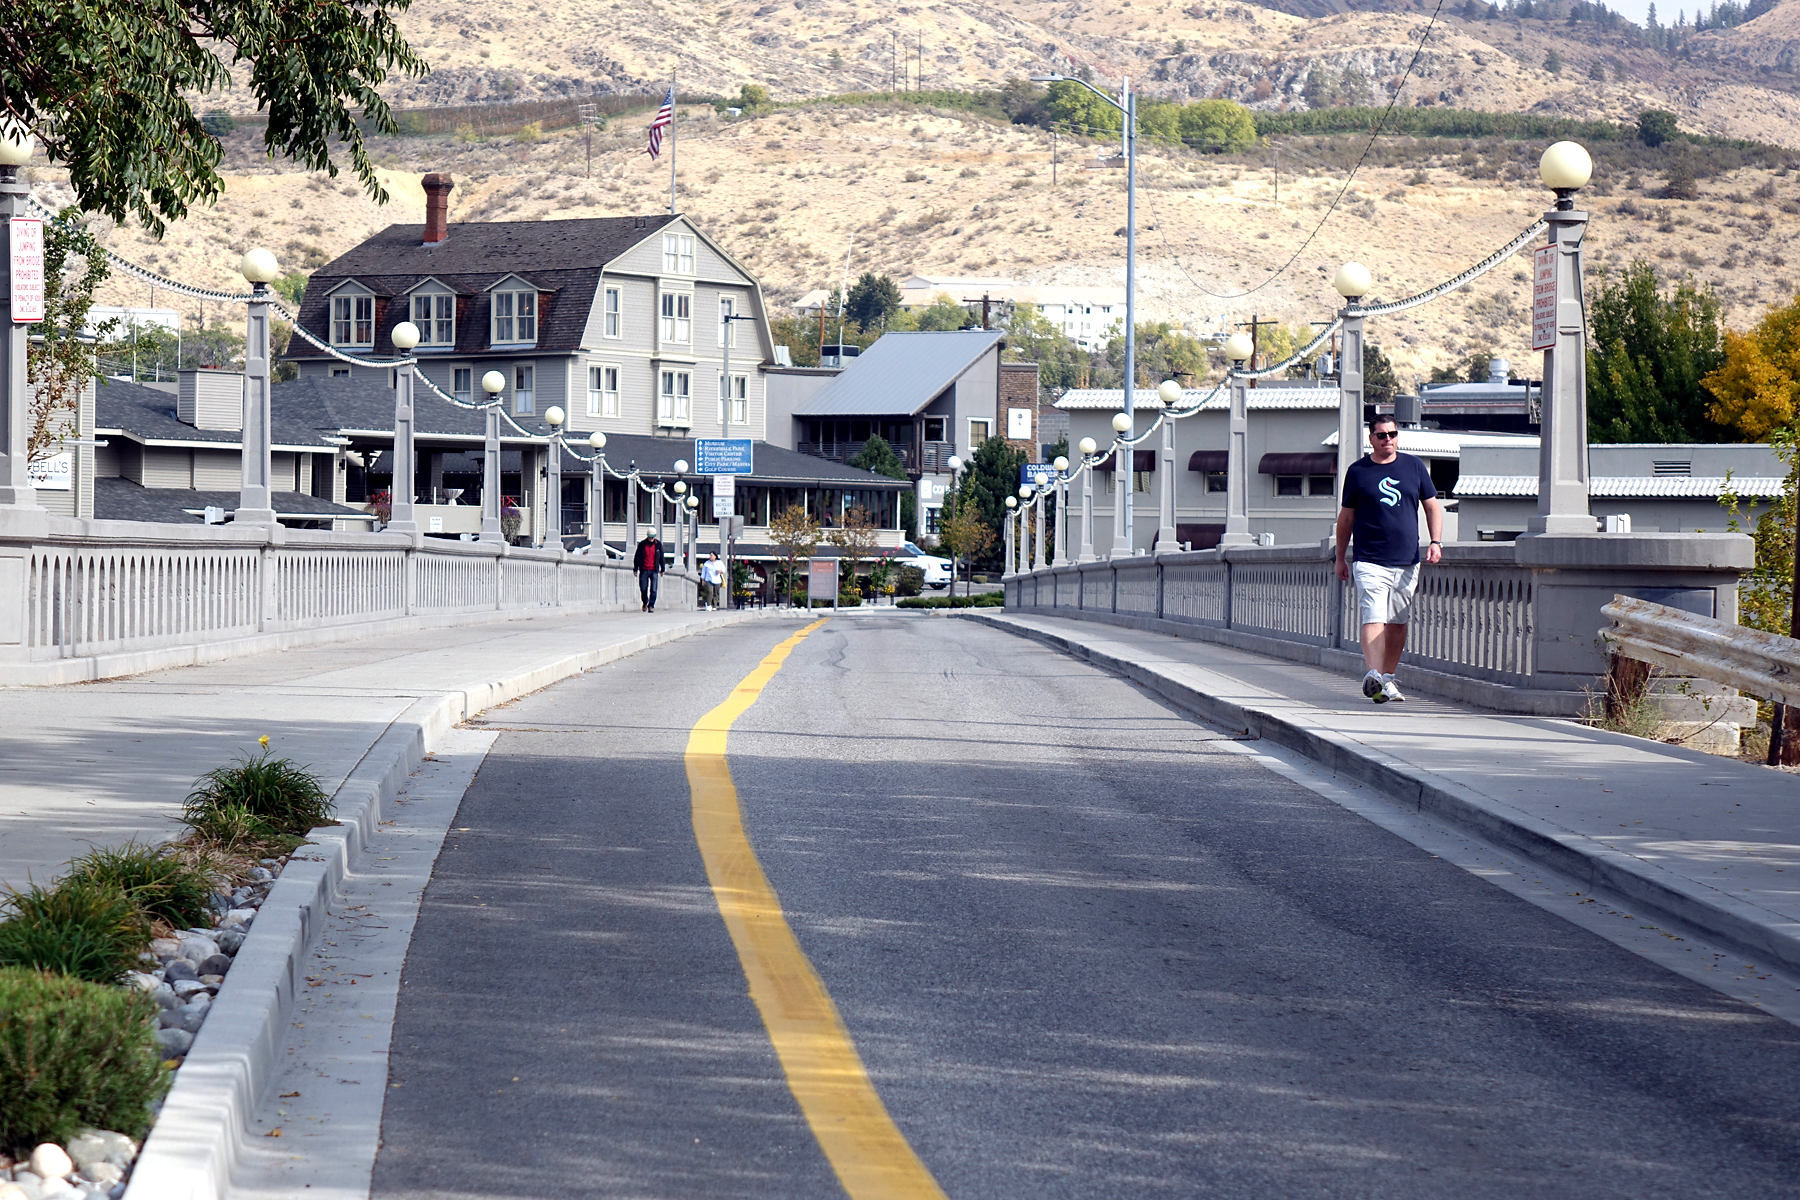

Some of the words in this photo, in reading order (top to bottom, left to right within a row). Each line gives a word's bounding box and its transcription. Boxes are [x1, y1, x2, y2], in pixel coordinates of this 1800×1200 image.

[16, 227, 30, 237] DIVING
[31, 227, 37, 237] OR
[18, 242, 36, 252] JUMPING
[14, 256, 25, 266] FROM
[26, 256, 41, 266] BRIDGE
[1538, 254, 1548, 266] DIVING
[15, 270, 39, 280] PROHIBITED
[1539, 268, 1552, 280] JUMPING
[1535, 284, 1543, 295] FROM
[1544, 281, 1555, 293] BRIDGE
[1536, 296, 1554, 308] PROHIBITED
